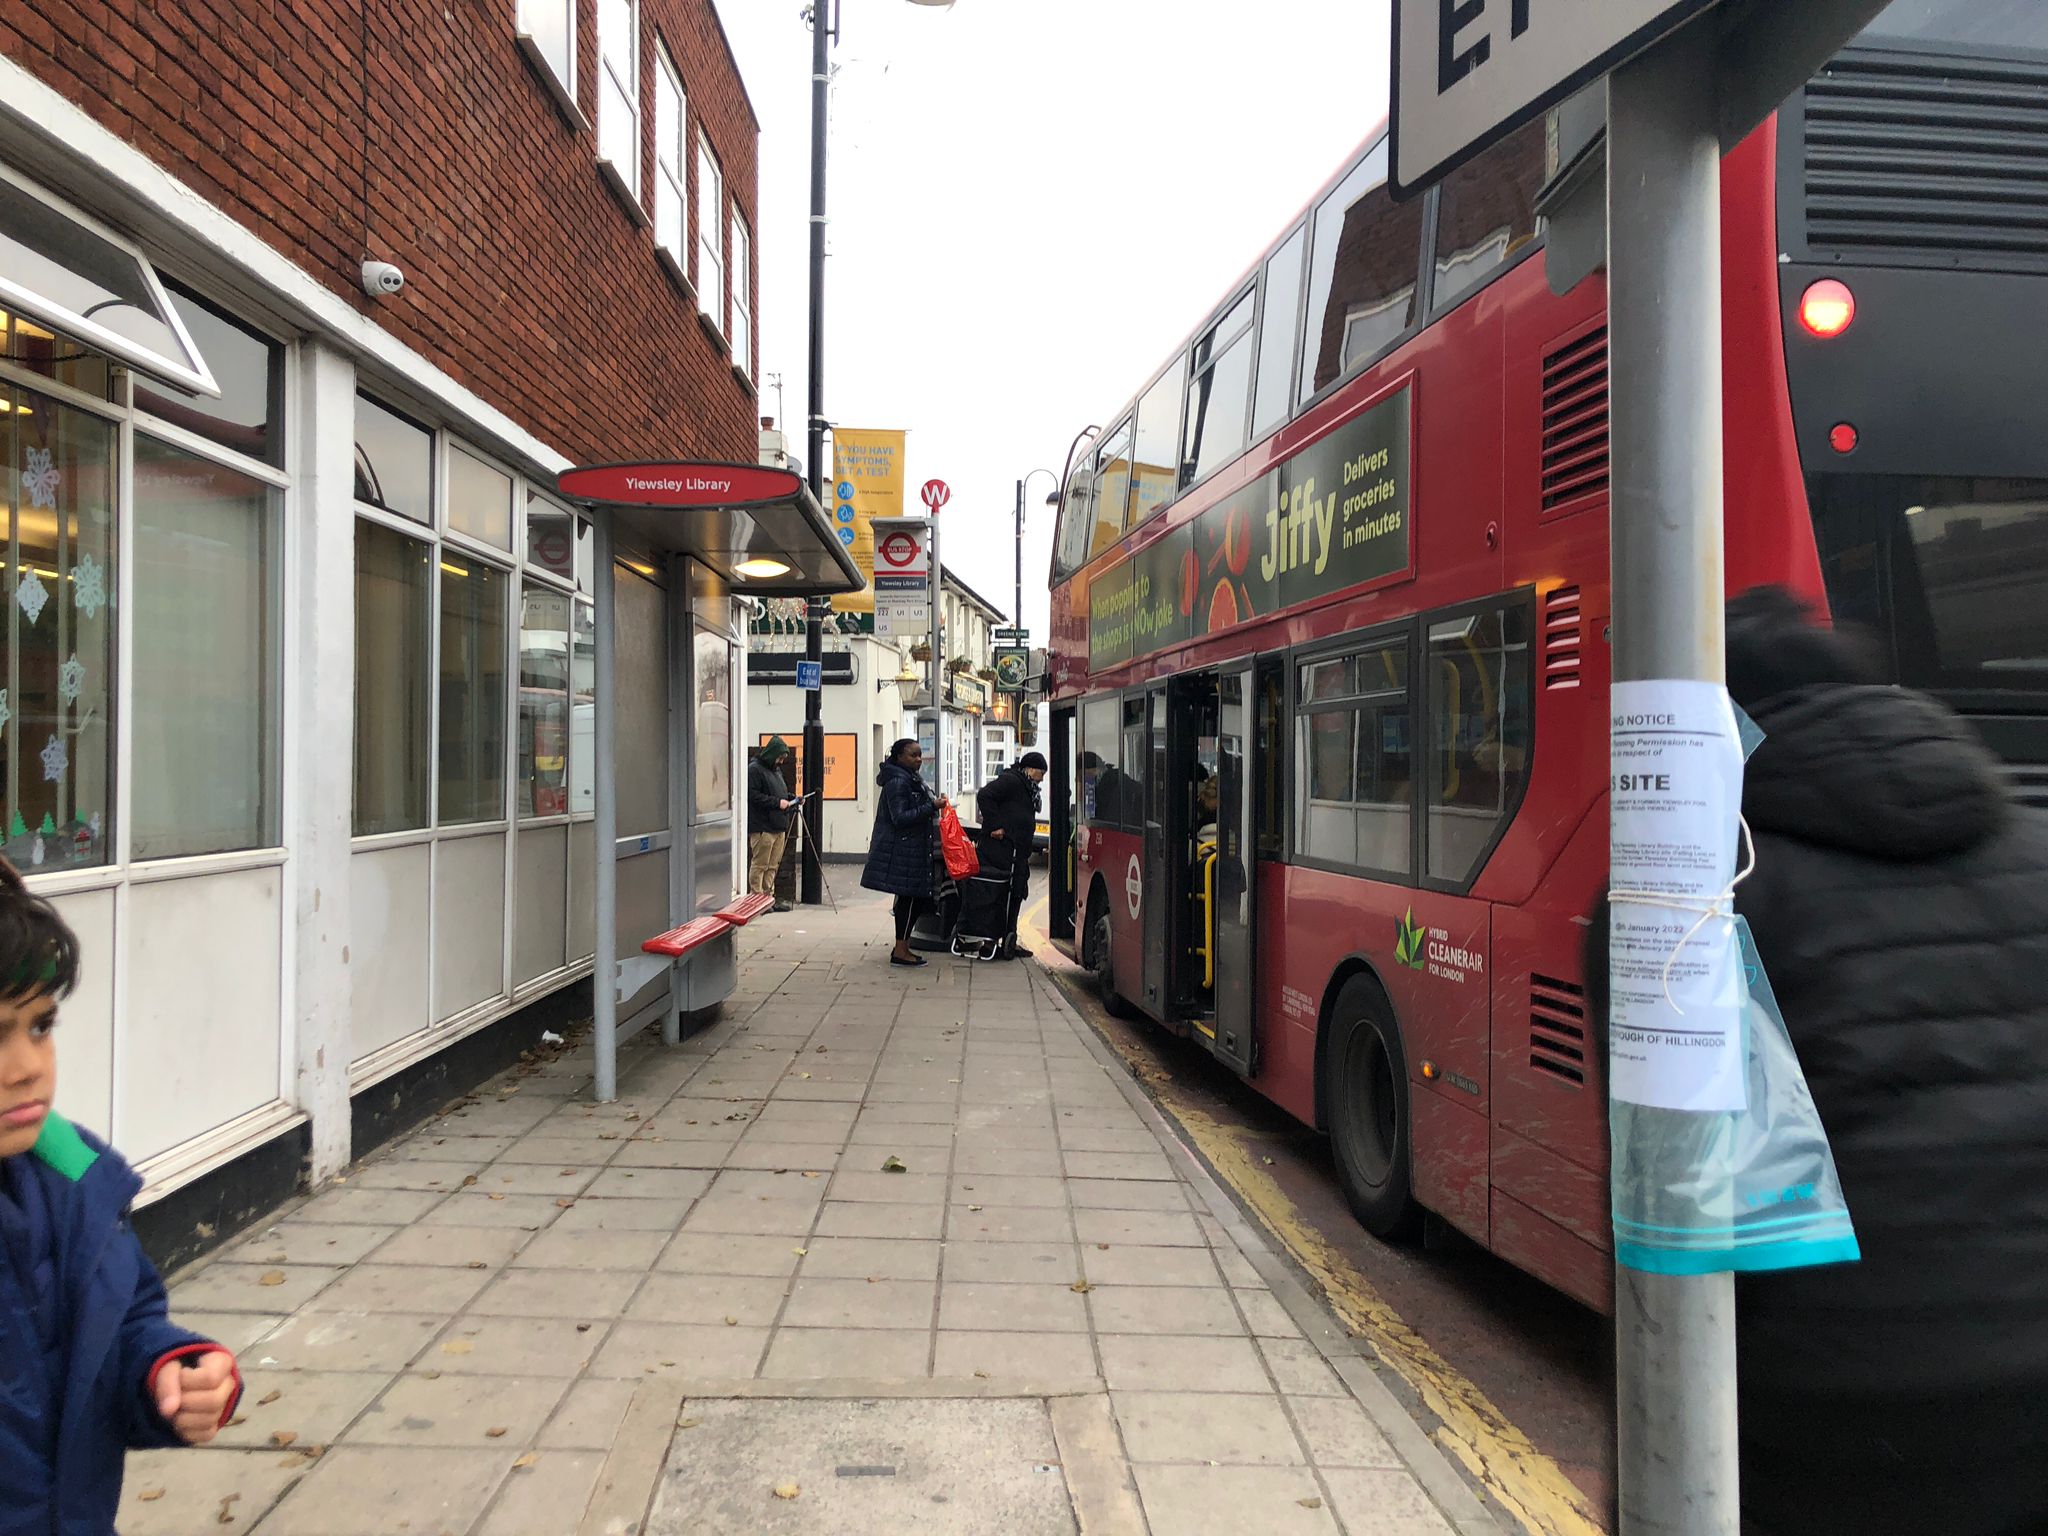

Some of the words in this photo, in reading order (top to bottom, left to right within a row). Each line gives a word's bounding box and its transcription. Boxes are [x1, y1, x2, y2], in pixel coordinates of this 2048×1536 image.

[848, 446, 866, 455] YOU
[869, 447, 894, 455] HAVE
[835, 466, 853, 475] GET
[866, 467, 888, 477] TEST
[1343, 448, 1389, 486] Delivers
[625, 477, 683, 493] Yiewsley
[686, 477, 731, 493] Library
[923, 485, 948, 505] W
[1343, 477, 1396, 522] groceries
[1261, 476, 1337, 582] Jiffy
[1343, 527, 1353, 550] in
[1355, 510, 1401, 545] minutes
[1110, 580, 1139, 620] popping
[1141, 574, 1150, 598] to
[1103, 625, 1122, 653] shops
[1154, 598, 1173, 638] joke
[1626, 714, 1676, 726] NOTICE
[1637, 738, 1687, 747] Permission
[1689, 739, 1704, 747] has
[1622, 749, 1651, 757] respect
[1653, 748, 1663, 757] of
[1620, 774, 1671, 791] SITE
[1428, 926, 1448, 941] HYBRID
[1628, 923, 1660, 934] January
[1662, 924, 1684, 934] 2022
[1428, 963, 1439, 976] FOR
[1440, 967, 1465, 983] LONDON
[1647, 1035, 1661, 1044] OF
[1665, 1036, 1726, 1047] HILLINGDON
